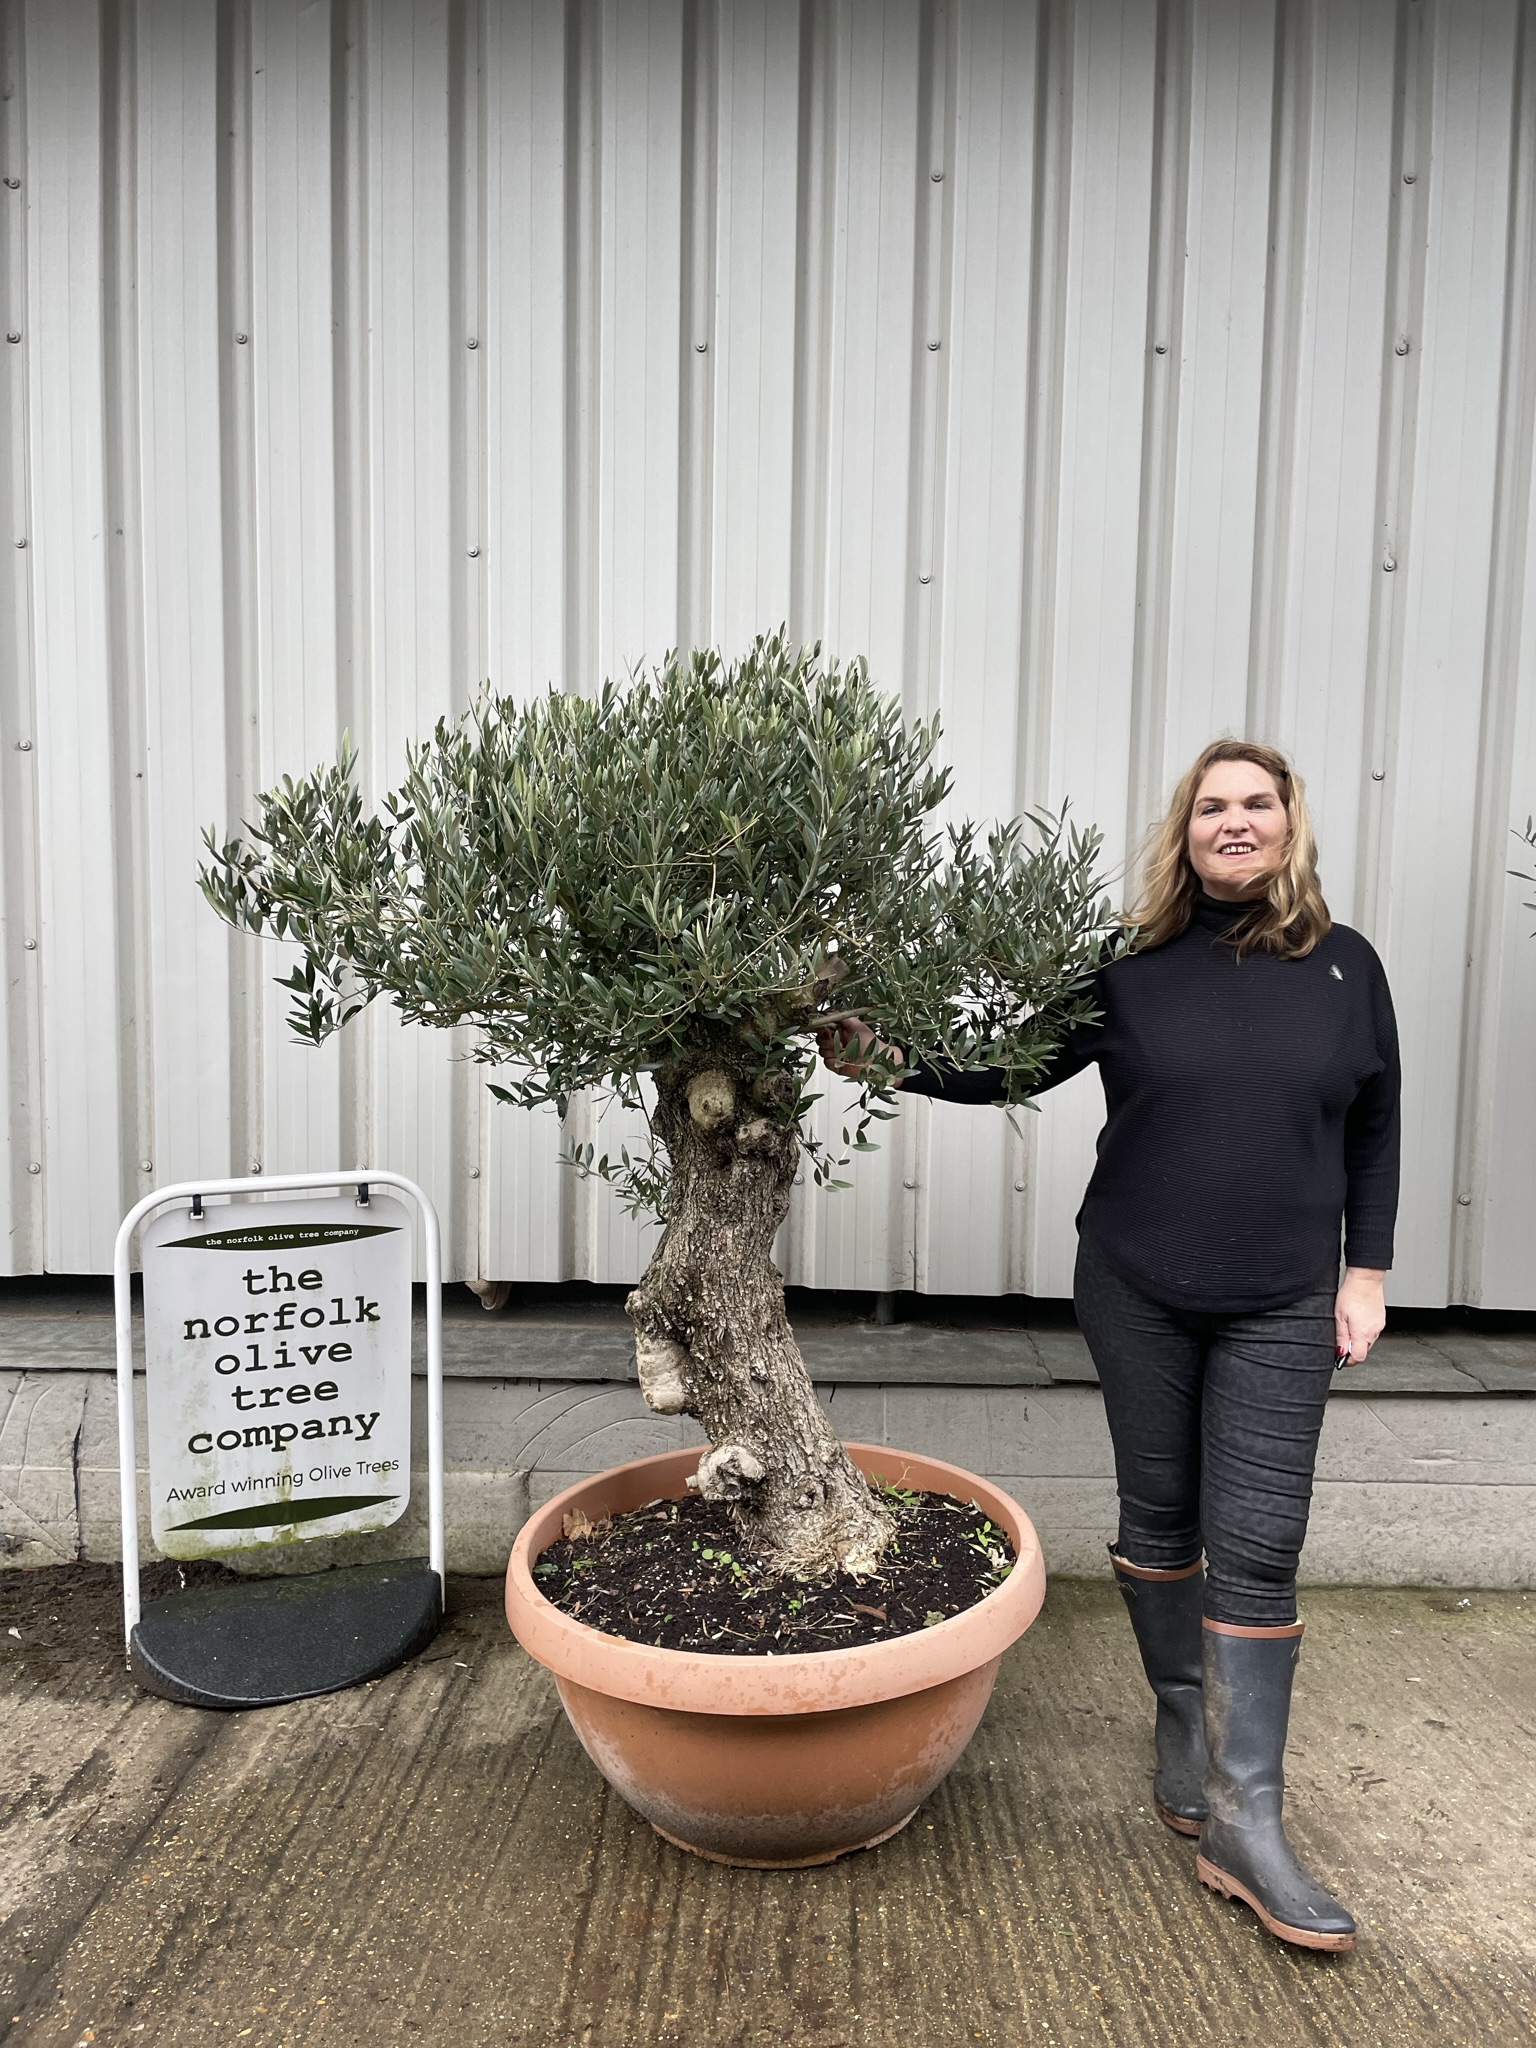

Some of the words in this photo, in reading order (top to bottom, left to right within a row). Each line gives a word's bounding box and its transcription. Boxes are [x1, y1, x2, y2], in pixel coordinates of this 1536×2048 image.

[226, 1235, 264, 1245] norfolk
[323, 1229, 359, 1237] company
[242, 1265, 323, 1295] the
[183, 1295, 381, 1340] norfolk
[214, 1342, 353, 1375] olive
[231, 1381, 339, 1411] tree
[188, 1412, 381, 1454] company
[166, 1480, 226, 1503] Award
[231, 1472, 304, 1493] winning
[309, 1465, 352, 1482] Olive
[355, 1459, 400, 1475] Trees
